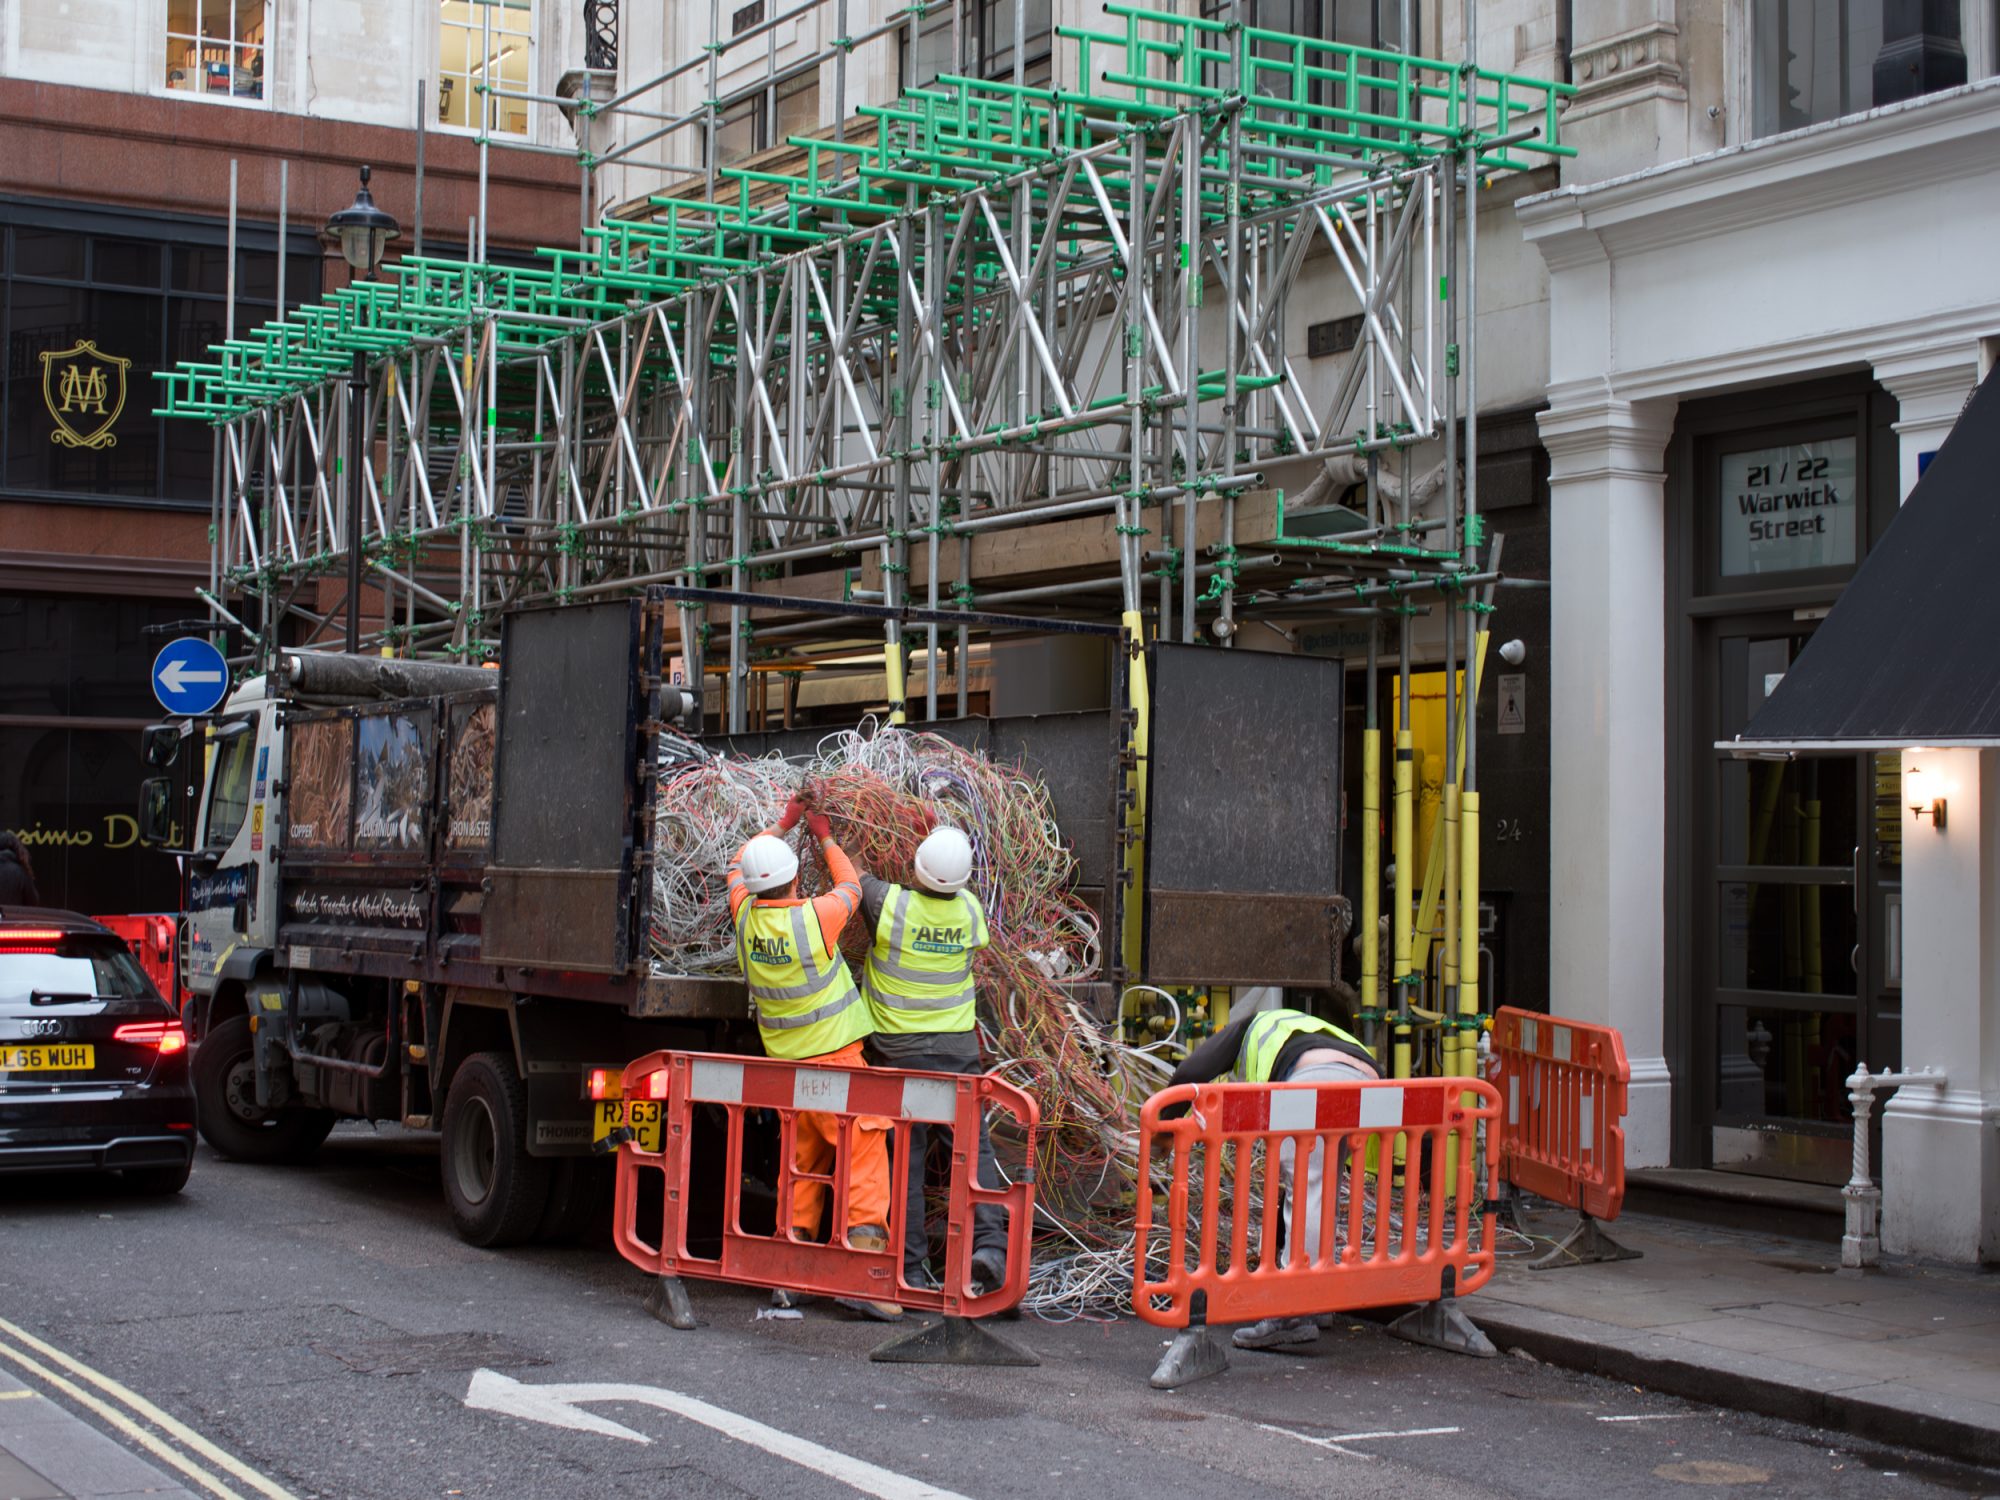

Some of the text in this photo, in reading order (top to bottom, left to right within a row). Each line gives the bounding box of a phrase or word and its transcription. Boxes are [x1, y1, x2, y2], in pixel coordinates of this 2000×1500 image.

[1747, 457, 1829, 488] 21 / 22
[1738, 484, 1839, 516] Warwick
[1749, 513, 1826, 542] Street
[187, 785, 194, 797] 3
[290, 824, 313, 838] COPPER
[359, 821, 399, 838] ALUMINIUM
[476, 821, 491, 837] STE
[1496, 818, 1522, 841] 24
[295, 890, 319, 914] Waste
[320, 895, 351, 917] Transfer
[359, 893, 384, 918] Metal
[383, 893, 423, 928] Recycling
[915, 926, 962, 945] AEM
[0, 1047, 87, 1068] L66 WUH
[538, 1126, 593, 1139] THOMPS
